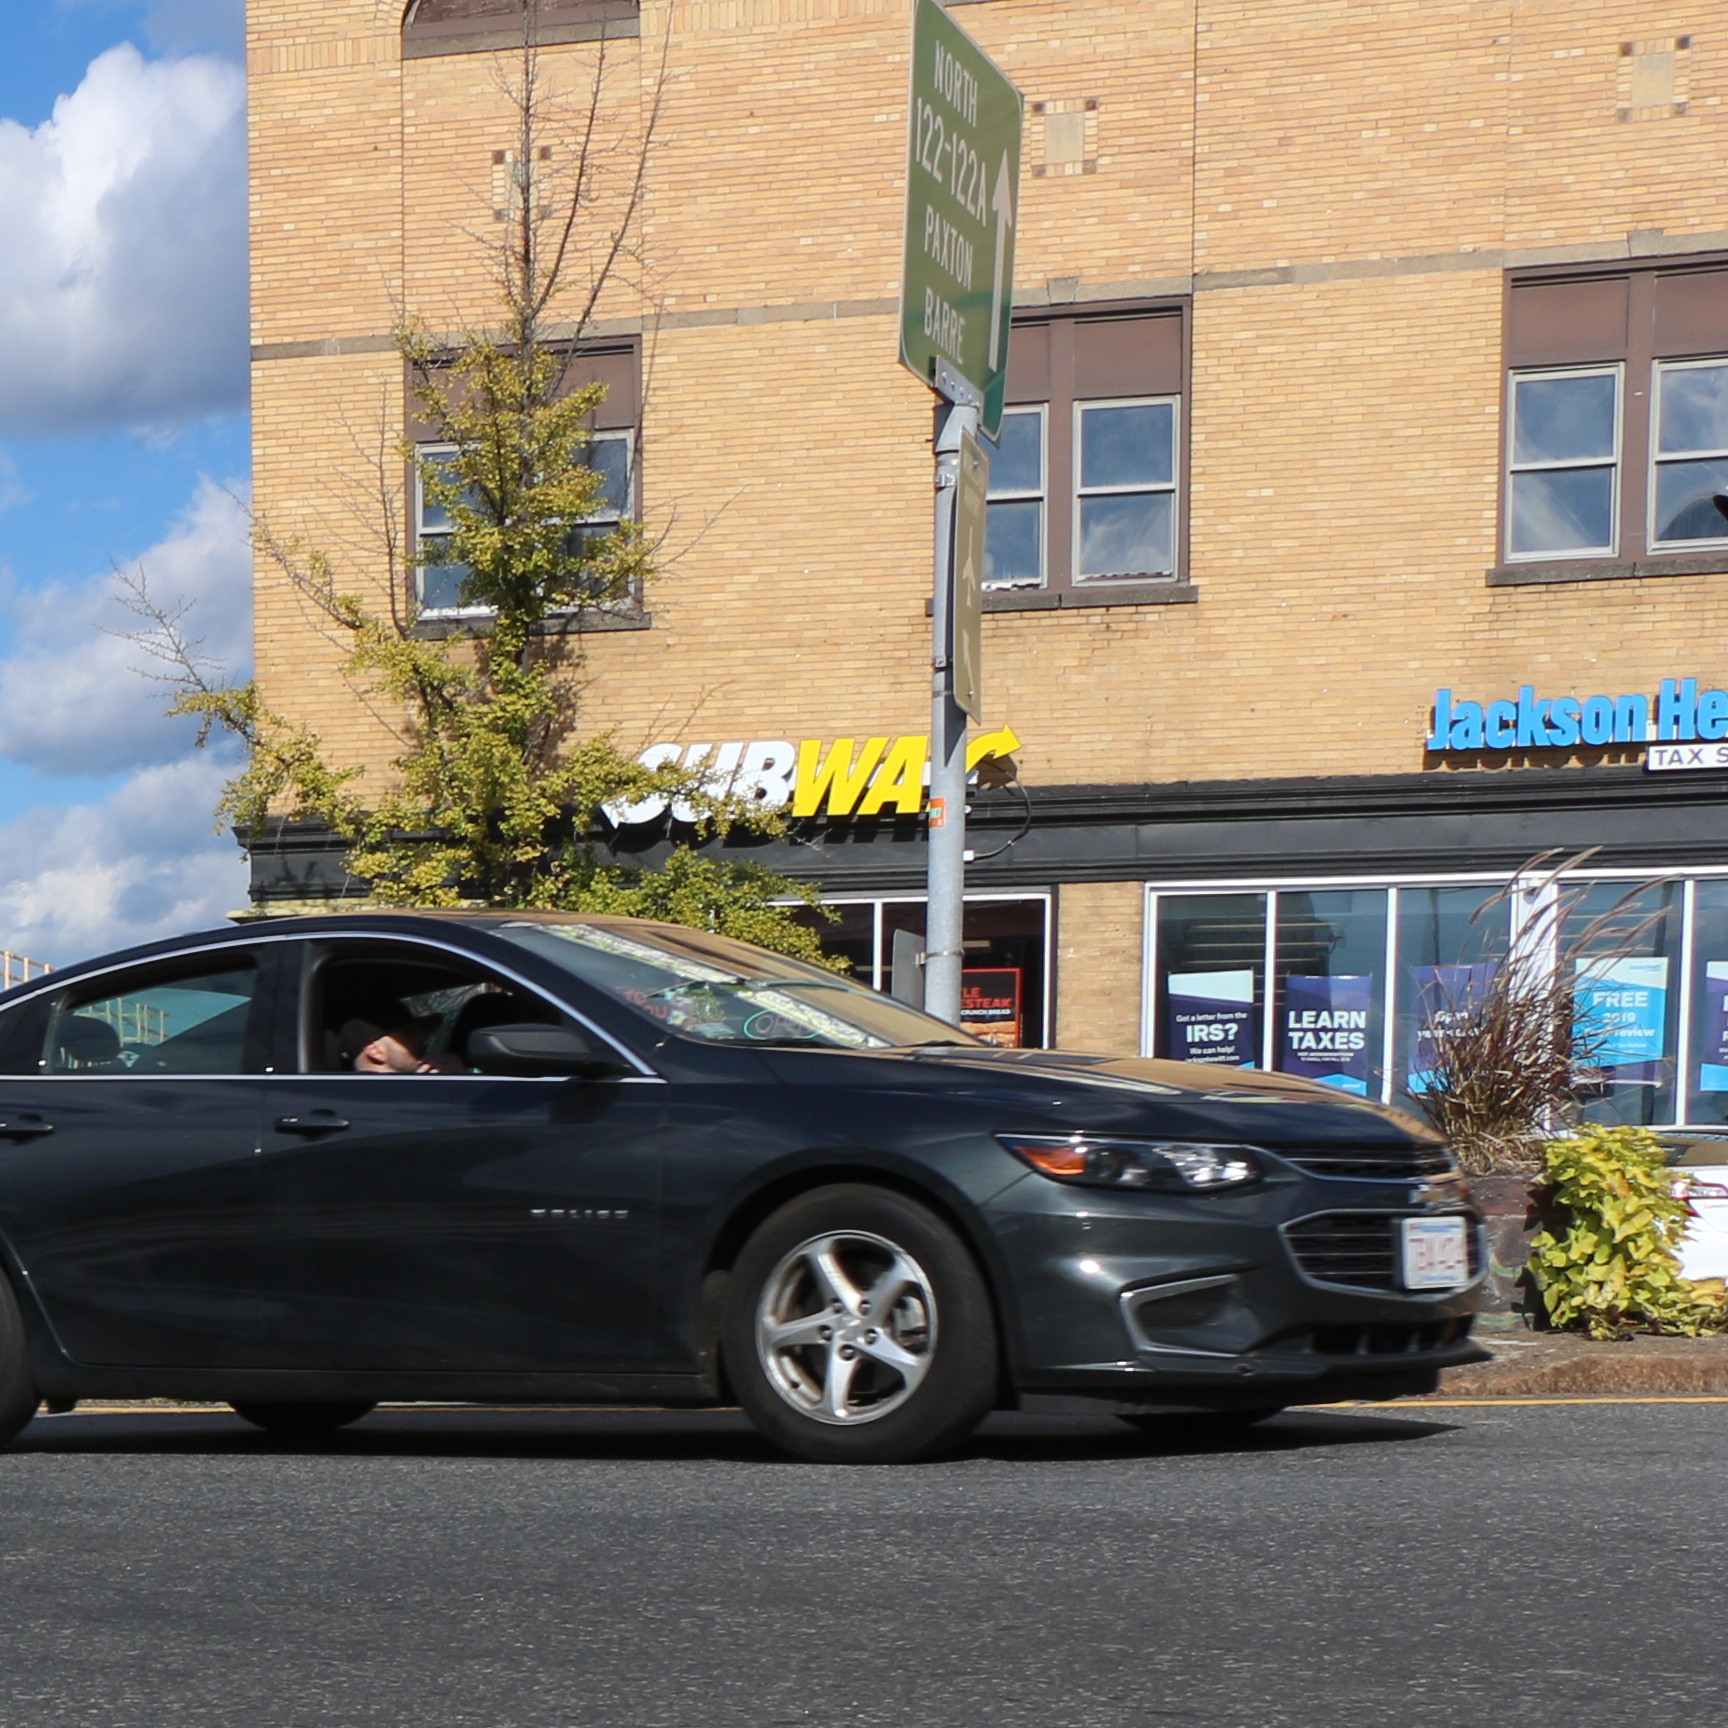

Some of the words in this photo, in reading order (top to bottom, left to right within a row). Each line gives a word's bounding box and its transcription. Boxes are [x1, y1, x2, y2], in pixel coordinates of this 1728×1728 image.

[933, 40, 978, 128] NORTH
[915, 97, 987, 227] 122-122A
[924, 204, 973, 292] PAXTON
[923, 288, 965, 365] BARRE
[1427, 686, 1648, 751] Jackson
[600, 724, 1021, 829] SUBWA
[1655, 749, 1703, 766] TAX
[1217, 1012, 1234, 1020] from
[1288, 1010, 1366, 1029] LEARN
[1592, 991, 1648, 1008] FREE
[1186, 1022, 1239, 1043] IRS?
[1288, 1031, 1366, 1050] TAXES
